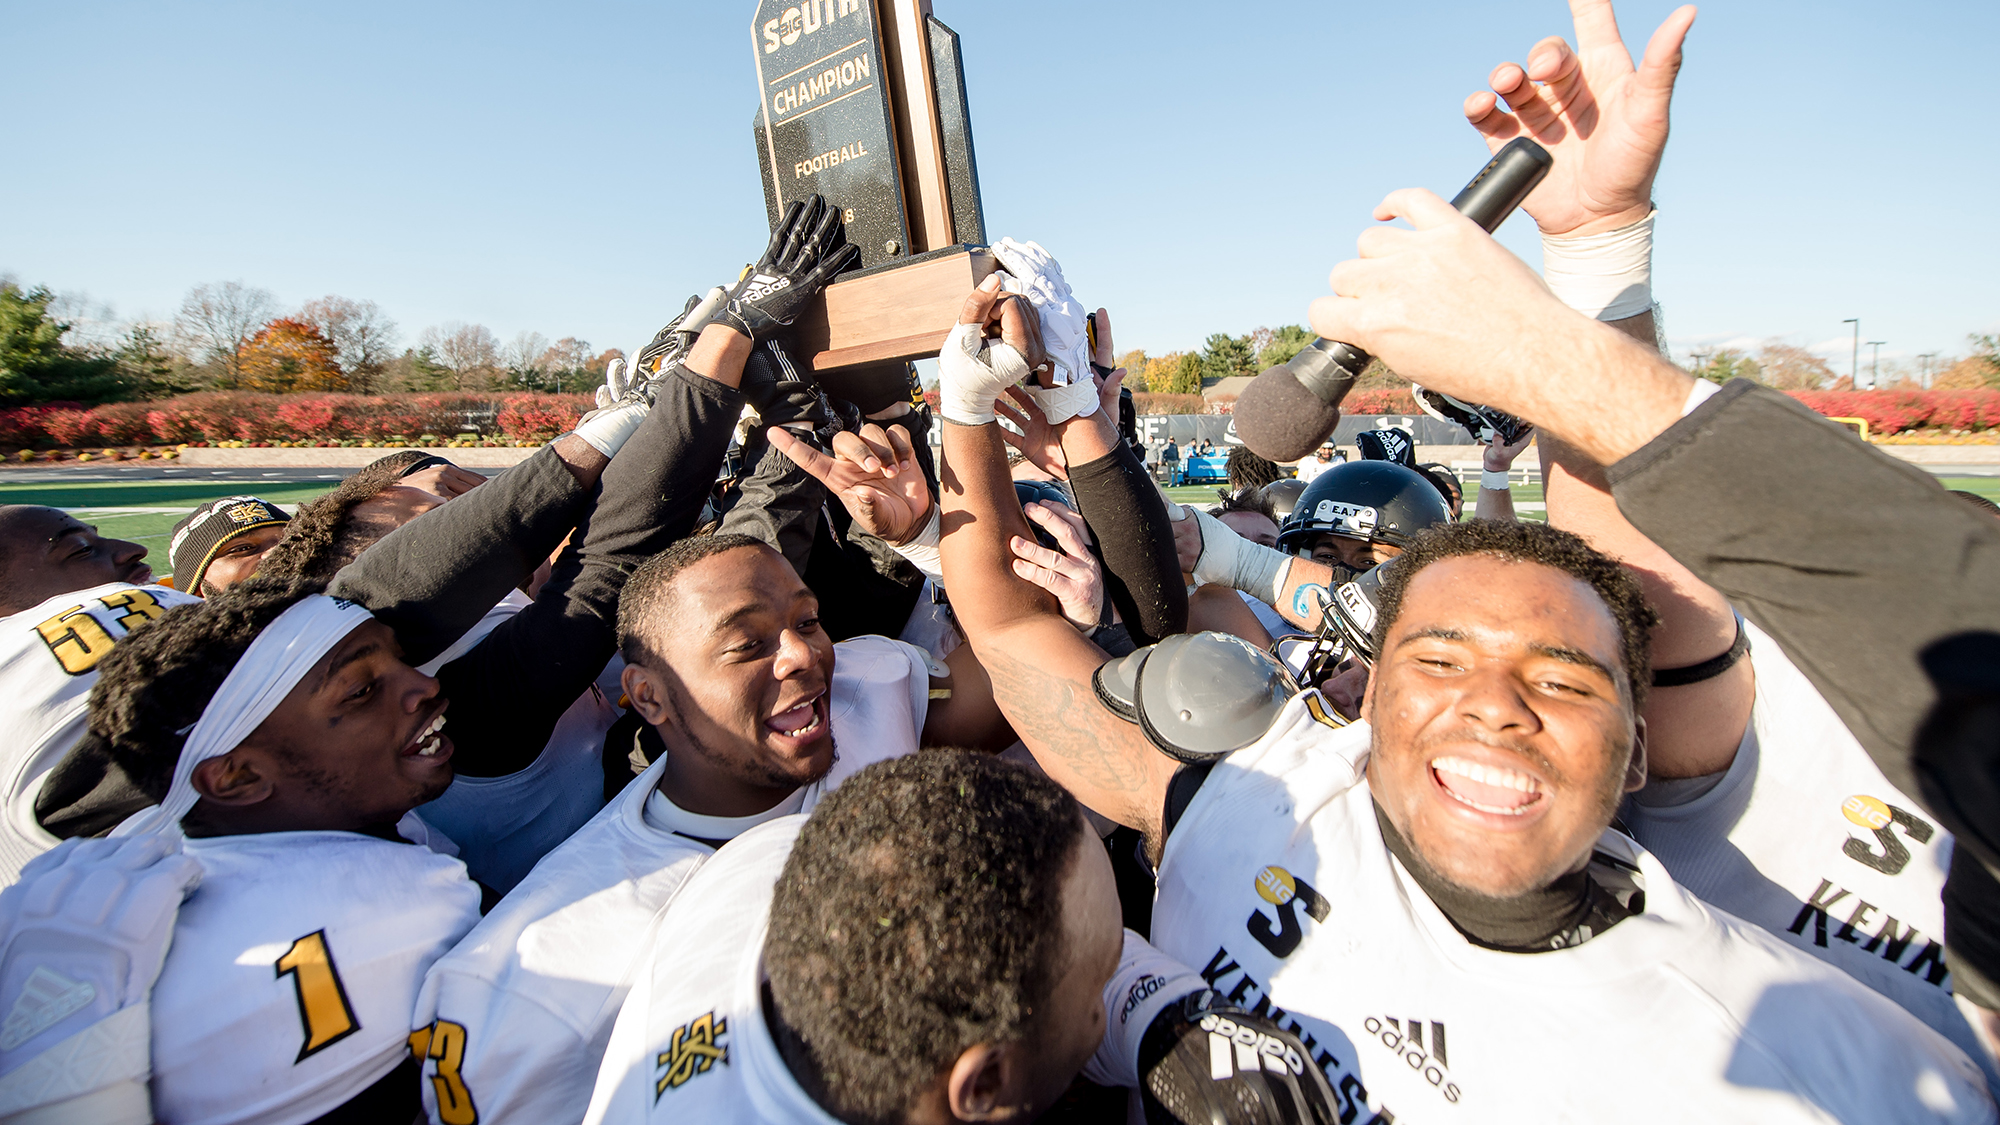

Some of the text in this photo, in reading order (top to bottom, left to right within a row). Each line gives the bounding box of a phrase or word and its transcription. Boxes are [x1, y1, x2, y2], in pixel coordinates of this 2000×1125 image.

[773, 52, 870, 115] CHAMPION
[794, 140, 868, 179] FOOTBALL
[740, 276, 791, 304] adidas
[1376, 430, 1397, 462] adidas
[32, 589, 168, 676] 53
[1842, 795, 1893, 829] BIG
[1256, 867, 1296, 904] BIG
[1786, 877, 1953, 997] KENN
[275, 927, 362, 1066] 1
[1200, 1013, 1304, 1076] adidas
[1363, 1016, 1462, 1103] adidas
